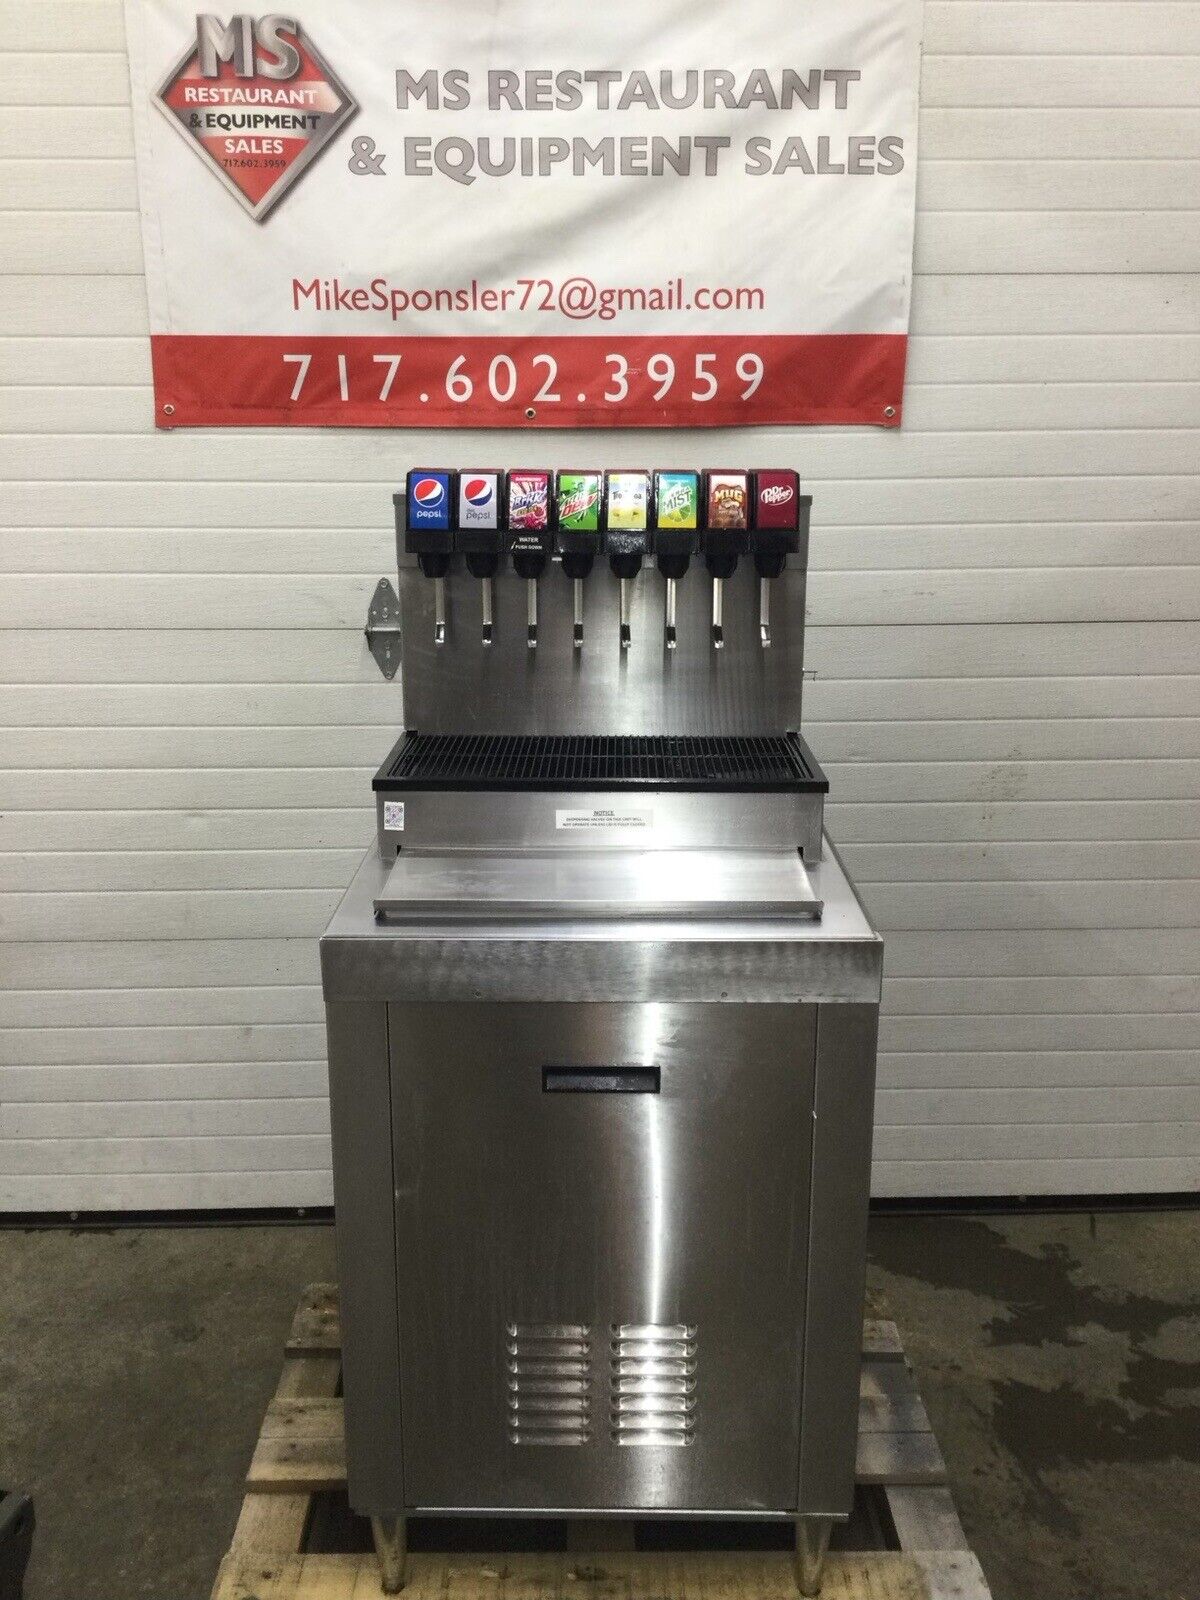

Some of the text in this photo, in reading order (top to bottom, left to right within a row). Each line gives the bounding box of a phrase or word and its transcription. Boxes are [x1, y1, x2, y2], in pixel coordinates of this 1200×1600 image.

[196, 13, 300, 80] MS
[184, 87, 318, 105] RESTAURANT
[394, 69, 861, 110] MS RESTAURANT
[189, 113, 321, 131] & EQUIPMENT
[225, 139, 284, 154] SALES
[223, 159, 287, 168] 717.602.3959
[347, 136, 905, 186] & EQUIPMENT SALES
[291, 278, 766, 321] MikeSponsler72@gmail.com
[282, 352, 767, 403] 717.602.3959
[664, 490, 691, 510] MIST
[714, 489, 743, 503] MUG
[416, 510, 442, 519] pepsi
[465, 511, 491, 521] pepsi
